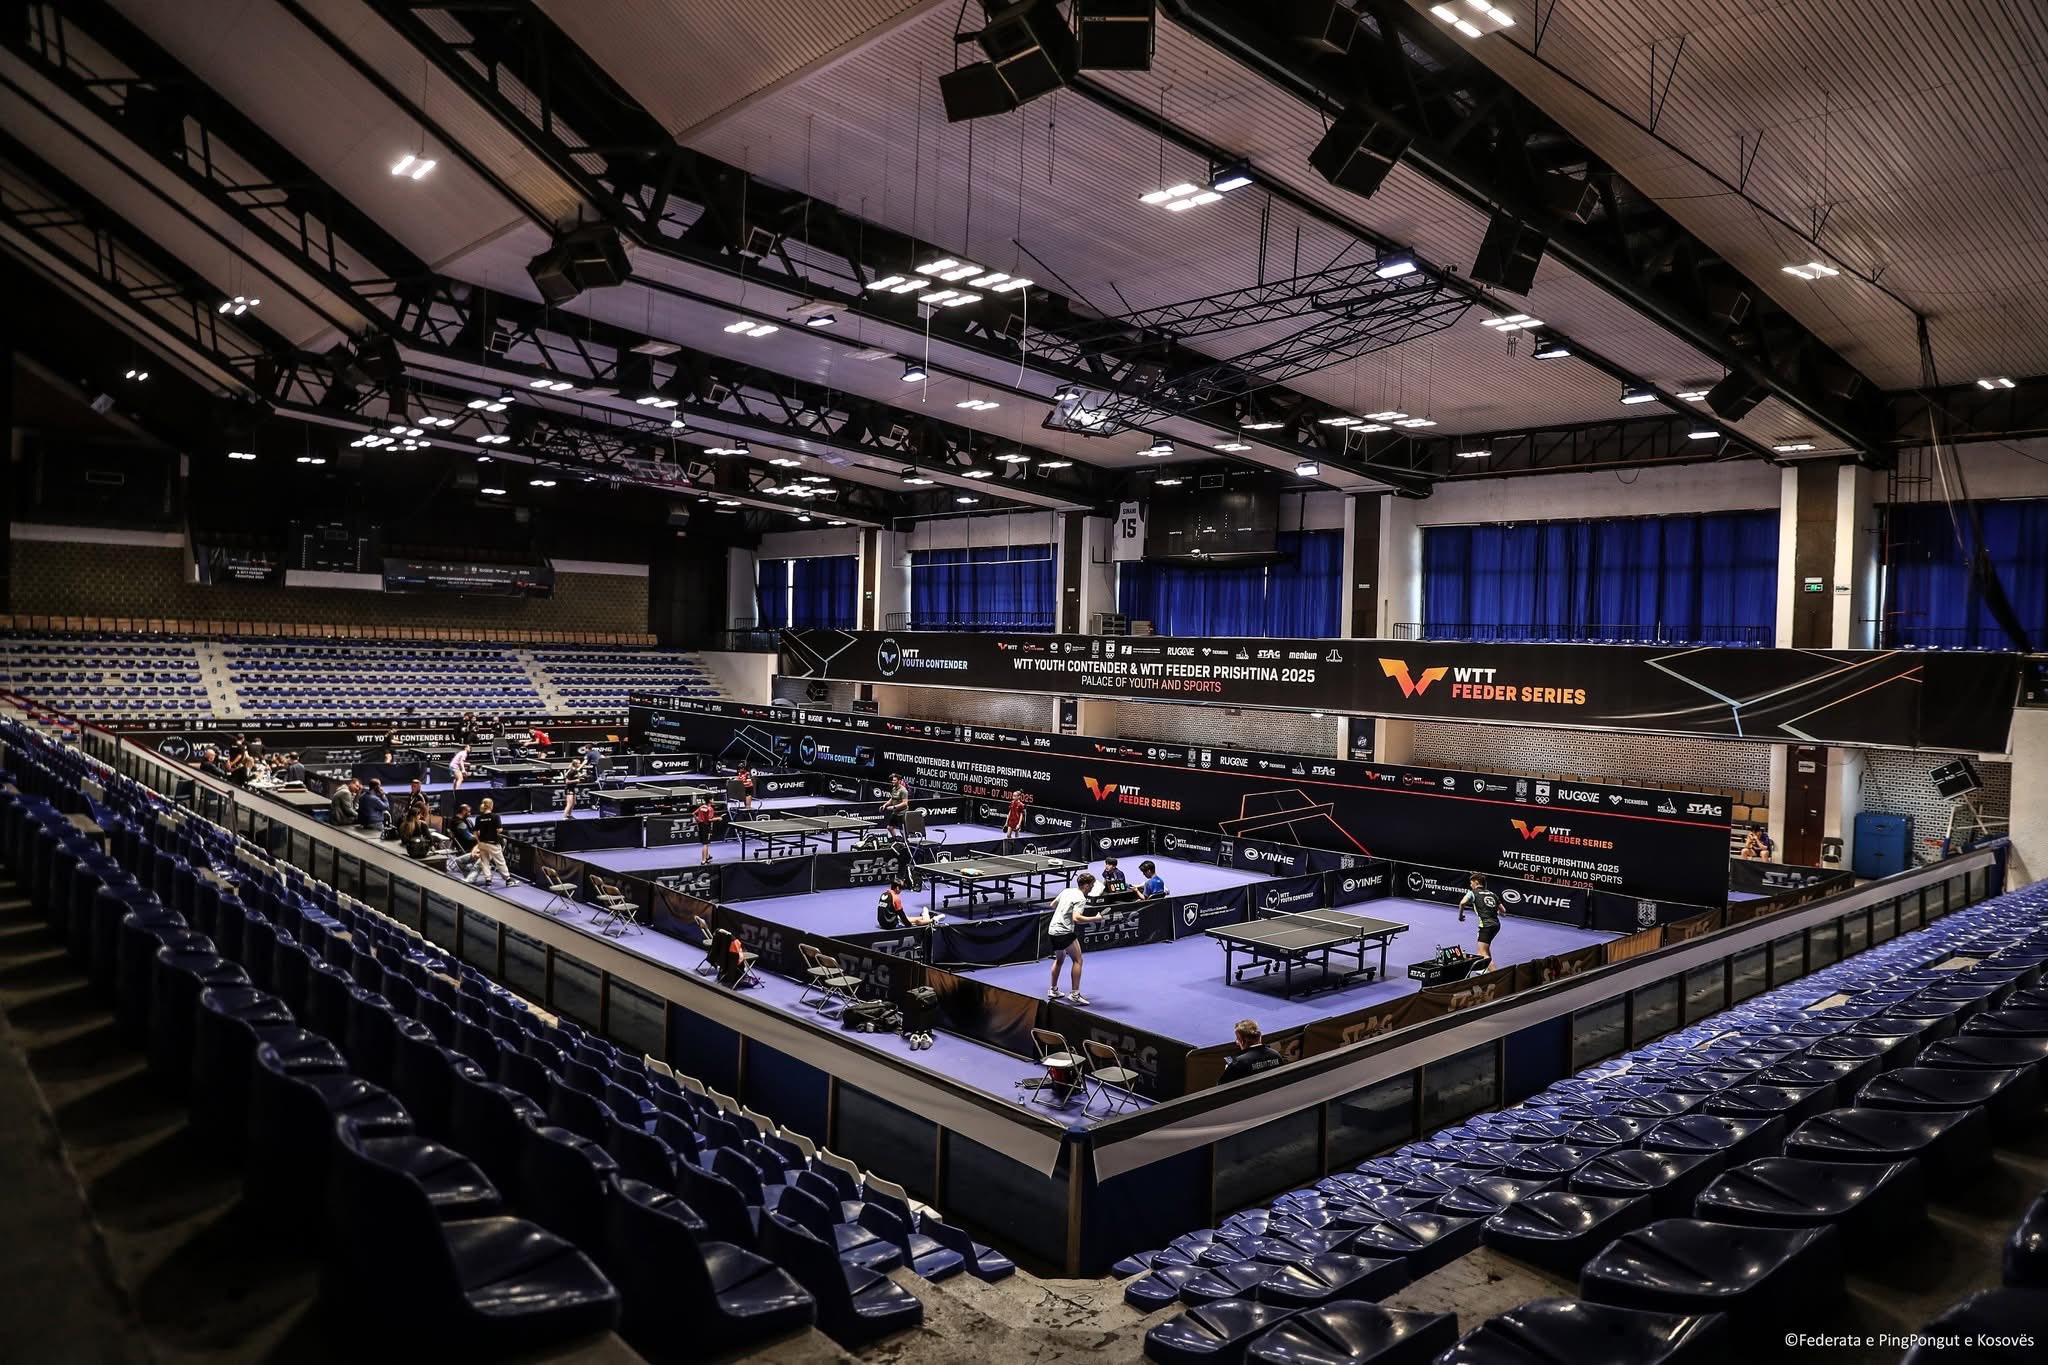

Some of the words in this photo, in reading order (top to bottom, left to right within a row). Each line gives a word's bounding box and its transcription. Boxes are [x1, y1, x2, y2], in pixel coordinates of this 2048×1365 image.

[1122, 518, 1136, 538] 15
[902, 648, 920, 658] WTT
[1257, 649, 1280, 659] STAG
[902, 658, 924, 668] YOUTH
[925, 658, 968, 670] CONTENDER
[1014, 658, 1034, 670] WTT
[1035, 658, 1066, 672] YOUTH
[1067, 660, 1128, 674] CONTENDER
[1130, 662, 1138, 675] &
[1140, 663, 1164, 676] WTT
[1166, 664, 1210, 678] FEEDER
[1213, 666, 1278, 681] PRISHTINA
[1281, 668, 1316, 683] 2025
[1453, 666, 1496, 684] WTT
[1081, 675, 1114, 687] PALACE
[1115, 676, 1128, 688] OF
[1129, 677, 1159, 690] YOUTH
[1160, 679, 1182, 690] AND
[1183, 680, 1222, 692] SPORTS
[1452, 683, 1517, 702] FEEDER
[1521, 686, 1586, 705] SERIES
[818, 744, 830, 752] WTT
[817, 752, 834, 761] YOUTH
[834, 753, 857, 764] CONTEN
[1220, 756, 1248, 768] RUGOVE
[884, 751, 896, 760] WTT
[896, 752, 914, 764] YOUTH
[914, 755, 950, 768] CONTENDER
[950, 759, 956, 768] &
[956, 760, 970, 771] WTT
[970, 762, 996, 774] FEEDER
[996, 766, 1032, 780] PRISHTINA
[1032, 770, 1050, 782] 2025
[1312, 766, 1336, 776] STAG
[916, 766, 938, 778] PALACE
[939, 769, 948, 778] OF
[948, 770, 968, 782] YOUTH
[969, 774, 983, 784] AND
[984, 775, 1008, 788] SPORTS
[1380, 774, 1396, 782] WTT
[778, 781, 806, 790] YINHE
[920, 778, 928, 787] 01
[928, 780, 941, 789] JUN
[942, 781, 958, 792] 2025
[964, 784, 972, 793] 03
[973, 786, 986, 796] JUN
[991, 788, 1000, 798] 07
[1119, 784, 1140, 796] WTT
[1118, 794, 1150, 807] FEEDER
[1150, 798, 1181, 812] SERIES
[1558, 789, 1600, 804] RUGOVE
[928, 806, 958, 816] YINHE
[1686, 803, 1722, 816] STAG
[1046, 818, 1072, 828] YINHE
[1550, 826, 1571, 836] WTT
[1112, 836, 1140, 846] YINHE
[1548, 834, 1581, 846] FEEDER
[1582, 838, 1614, 850] SERIES
[850, 856, 899, 874] STAG
[1260, 851, 1295, 866] YINHE
[1502, 850, 1520, 860] WTT
[1520, 852, 1550, 864] FEEDER
[1552, 856, 1596, 870] PRISHTINA
[1597, 862, 1620, 874] 2025
[1498, 860, 1528, 872] PALACE
[1530, 864, 1540, 873] OF
[1542, 865, 1569, 877] YOUTH
[1570, 870, 1588, 880] AND
[1590, 872, 1623, 885] SPORTS
[1356, 874, 1383, 888] YINHE
[1524, 874, 1534, 882] 03
[1556, 878, 1571, 887] JUN
[1572, 880, 1594, 890] 2025
[1522, 893, 1571, 908] YINHE
[740, 923, 782, 952] STAG
[1084, 931, 1139, 944] GLOBAL
[1410, 970, 1426, 978] STAG
